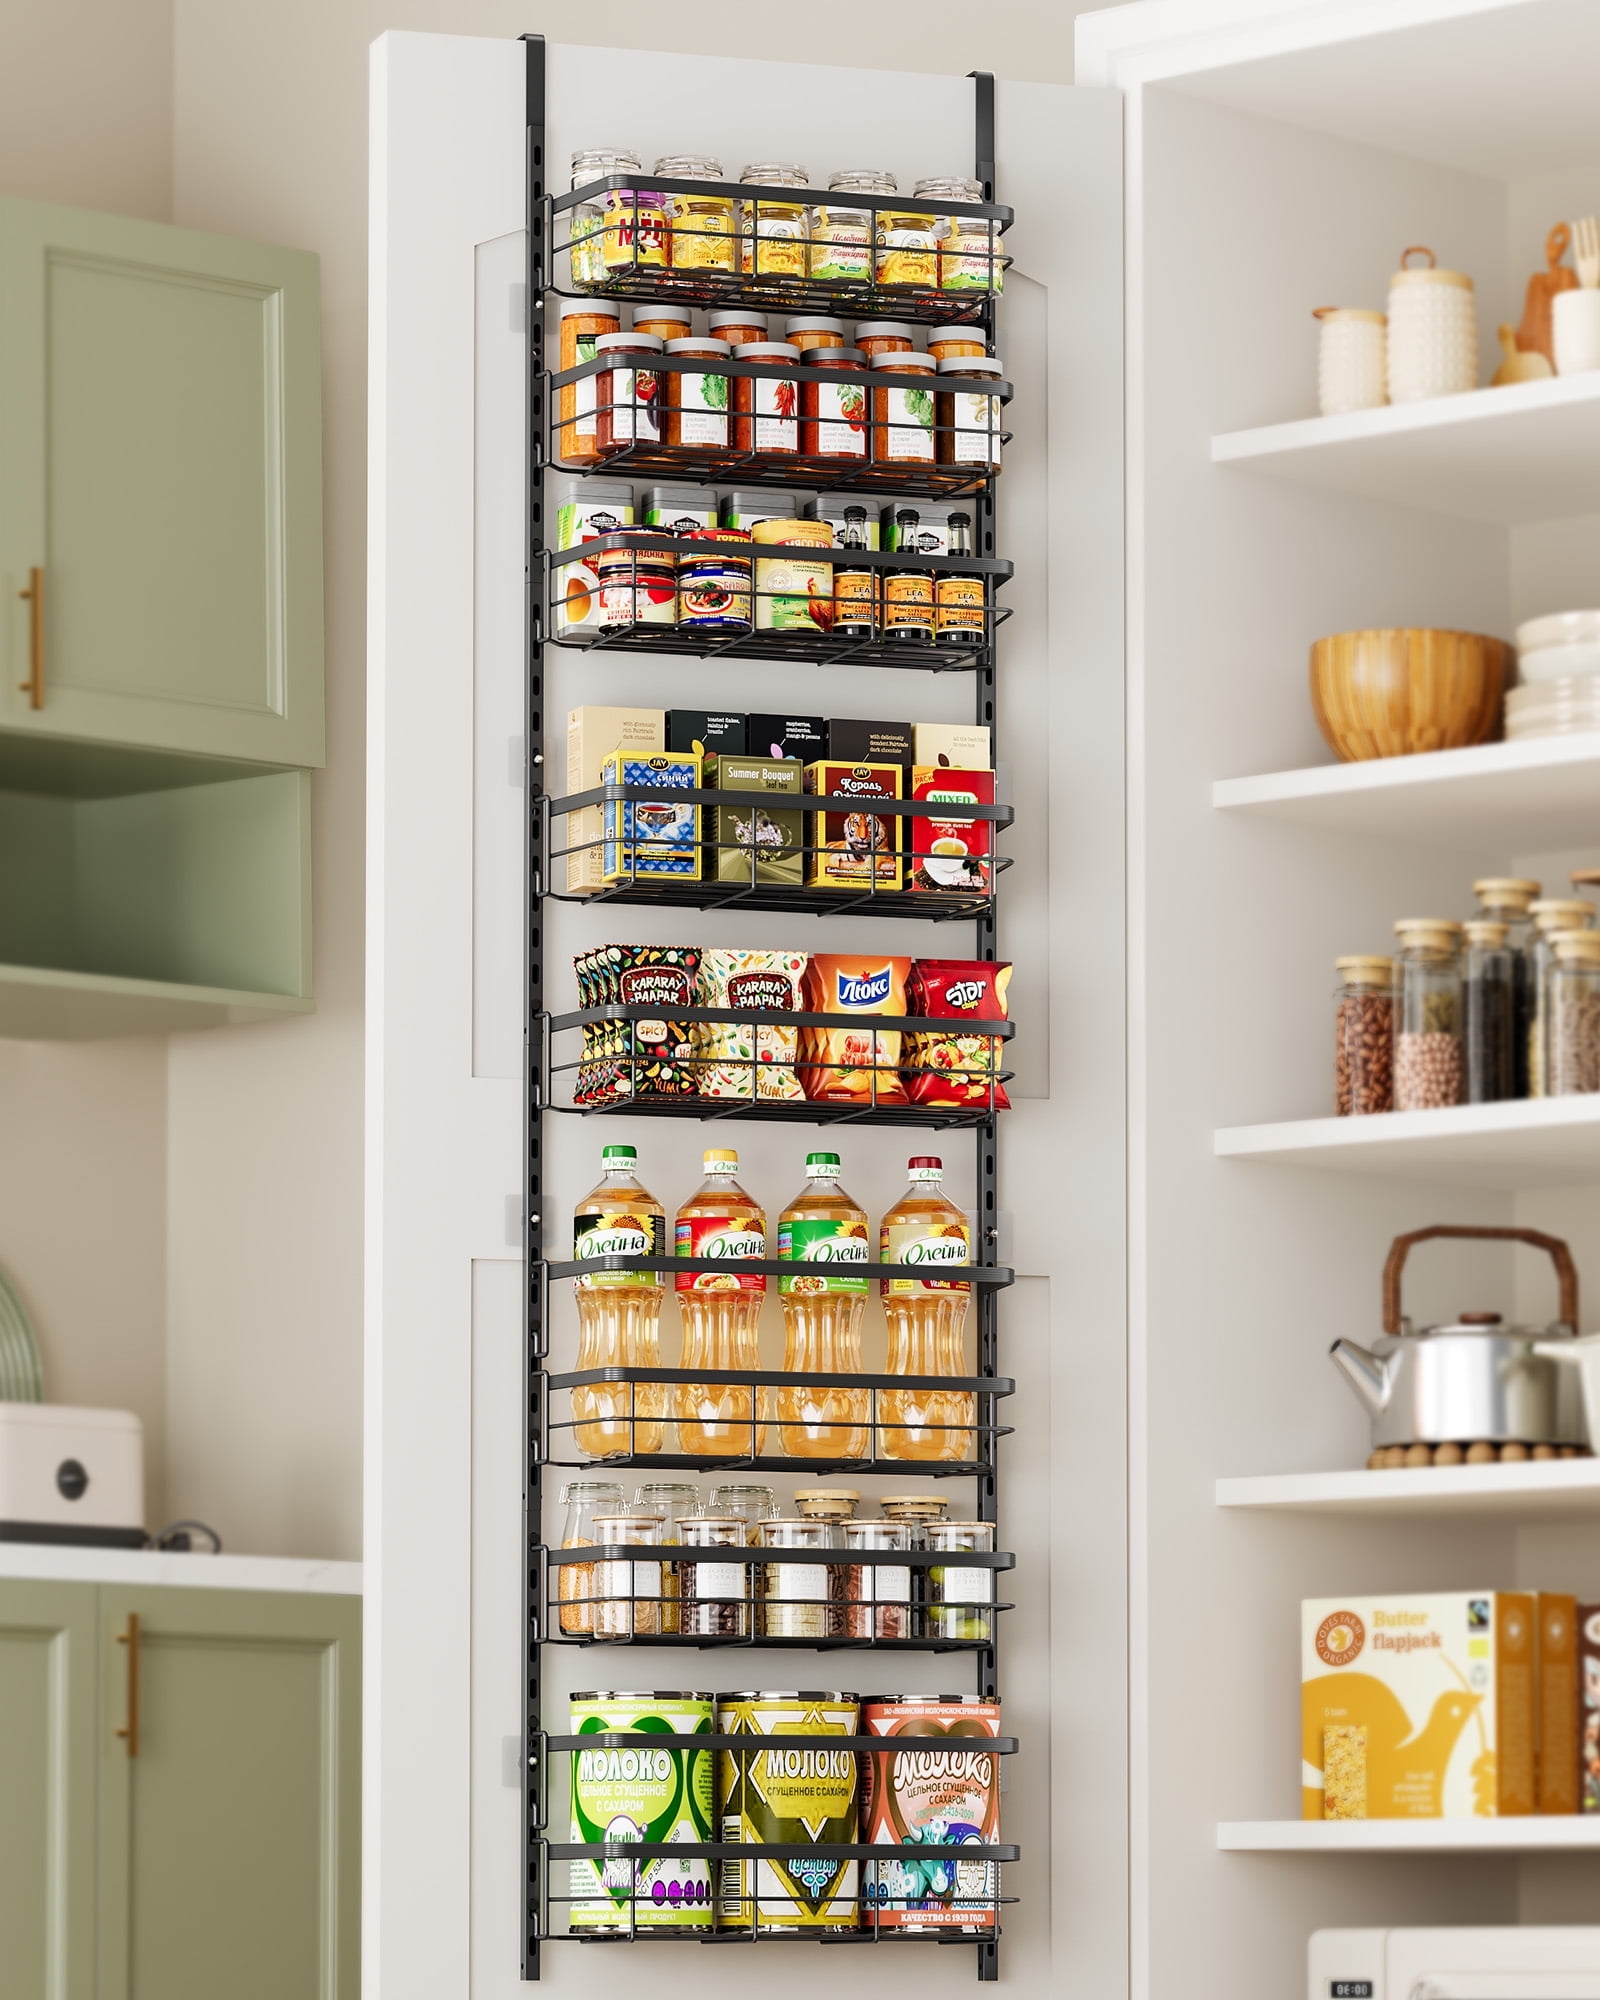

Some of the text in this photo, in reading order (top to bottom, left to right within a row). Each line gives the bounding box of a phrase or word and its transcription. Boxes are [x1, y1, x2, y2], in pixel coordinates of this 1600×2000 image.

[650, 759, 667, 768] JAY
[728, 766, 794, 783] Summer Bouquet
[914, 775, 934, 784] PACK
[766, 780, 788, 790] leaf tea
[840, 778, 883, 793] Король
[631, 975, 683, 992] KARARAY
[736, 980, 788, 996] KARARAY
[839, 978, 888, 1001] Люкс
[634, 990, 680, 1005] PAAPAR
[740, 995, 784, 1009] PAAPAR
[640, 1026, 666, 1036] SPICY
[580, 1235, 645, 1260] Олейна
[706, 1237, 766, 1259] Олейна
[905, 1243, 967, 1265] Олейна
[1372, 1610, 1429, 1628] Butter
[1317, 1614, 1361, 1647] DOVES FARM
[1323, 1638, 1362, 1664] ORGANIC
[1372, 1631, 1443, 1654] flapjack
[581, 1749, 672, 1782] МОЛОКО
[766, 1750, 850, 1779] МОЛОКО
[893, 1748, 992, 1792] Молоко
[581, 1784, 667, 1798] ЦЕЛЬНОЕ СГУЩЕННОЕ
[767, 1786, 815, 1798] СГУЩЕННОЕ
[816, 1786, 821, 1796] С
[907, 1782, 982, 1799] ЦЕЛЬНОЕ СГУЩЕННОЕ
[597, 1800, 644, 1812] С САХАРОМ
[929, 1795, 967, 1806] С САХАРОМ
[900, 1913, 986, 1923] КАЧЕСТВО С 1939 ГОДА
